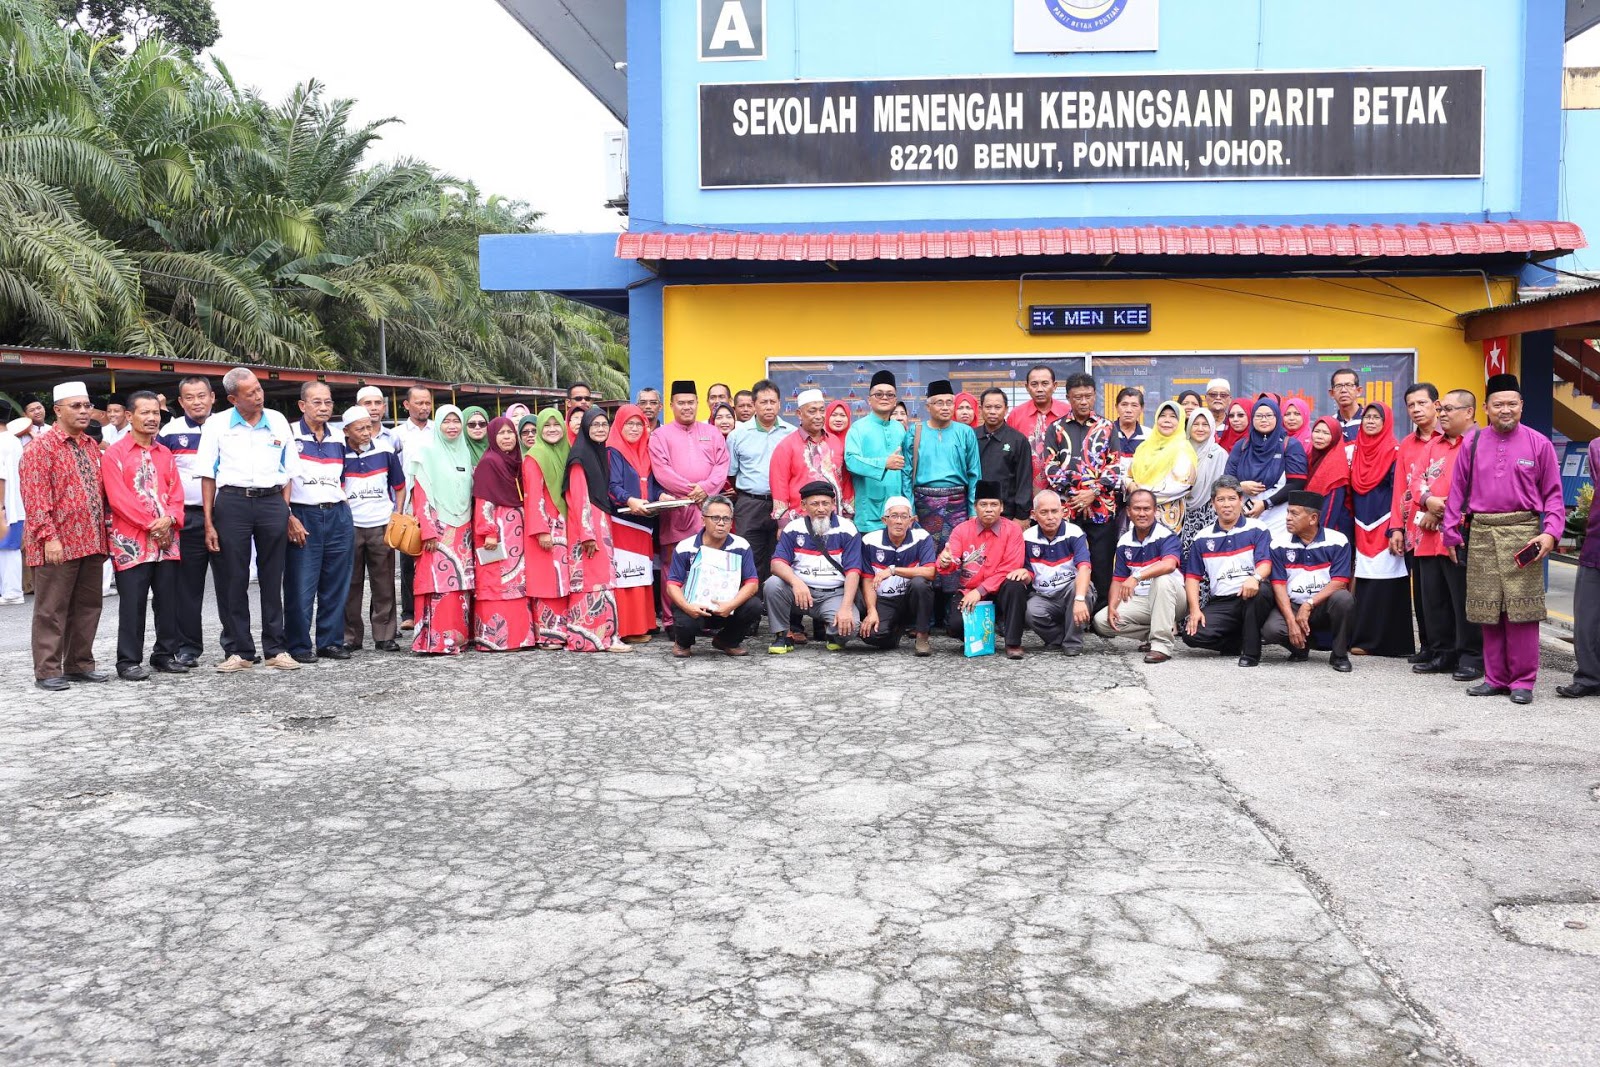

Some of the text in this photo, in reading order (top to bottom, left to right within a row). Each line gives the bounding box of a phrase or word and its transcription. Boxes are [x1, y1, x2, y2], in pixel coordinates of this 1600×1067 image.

[709, 0, 755, 50] A
[1053, 6, 1120, 29] PARIT BETAK PONTIAN
[732, 85, 1449, 136] SEKOLAH MENENGAH KEBANGSAAN PARIT BETAK
[890, 139, 1291, 172] 82210 BENUT, PONTIAN, JOHOR.
[1064, 310, 1104, 325] MEN
